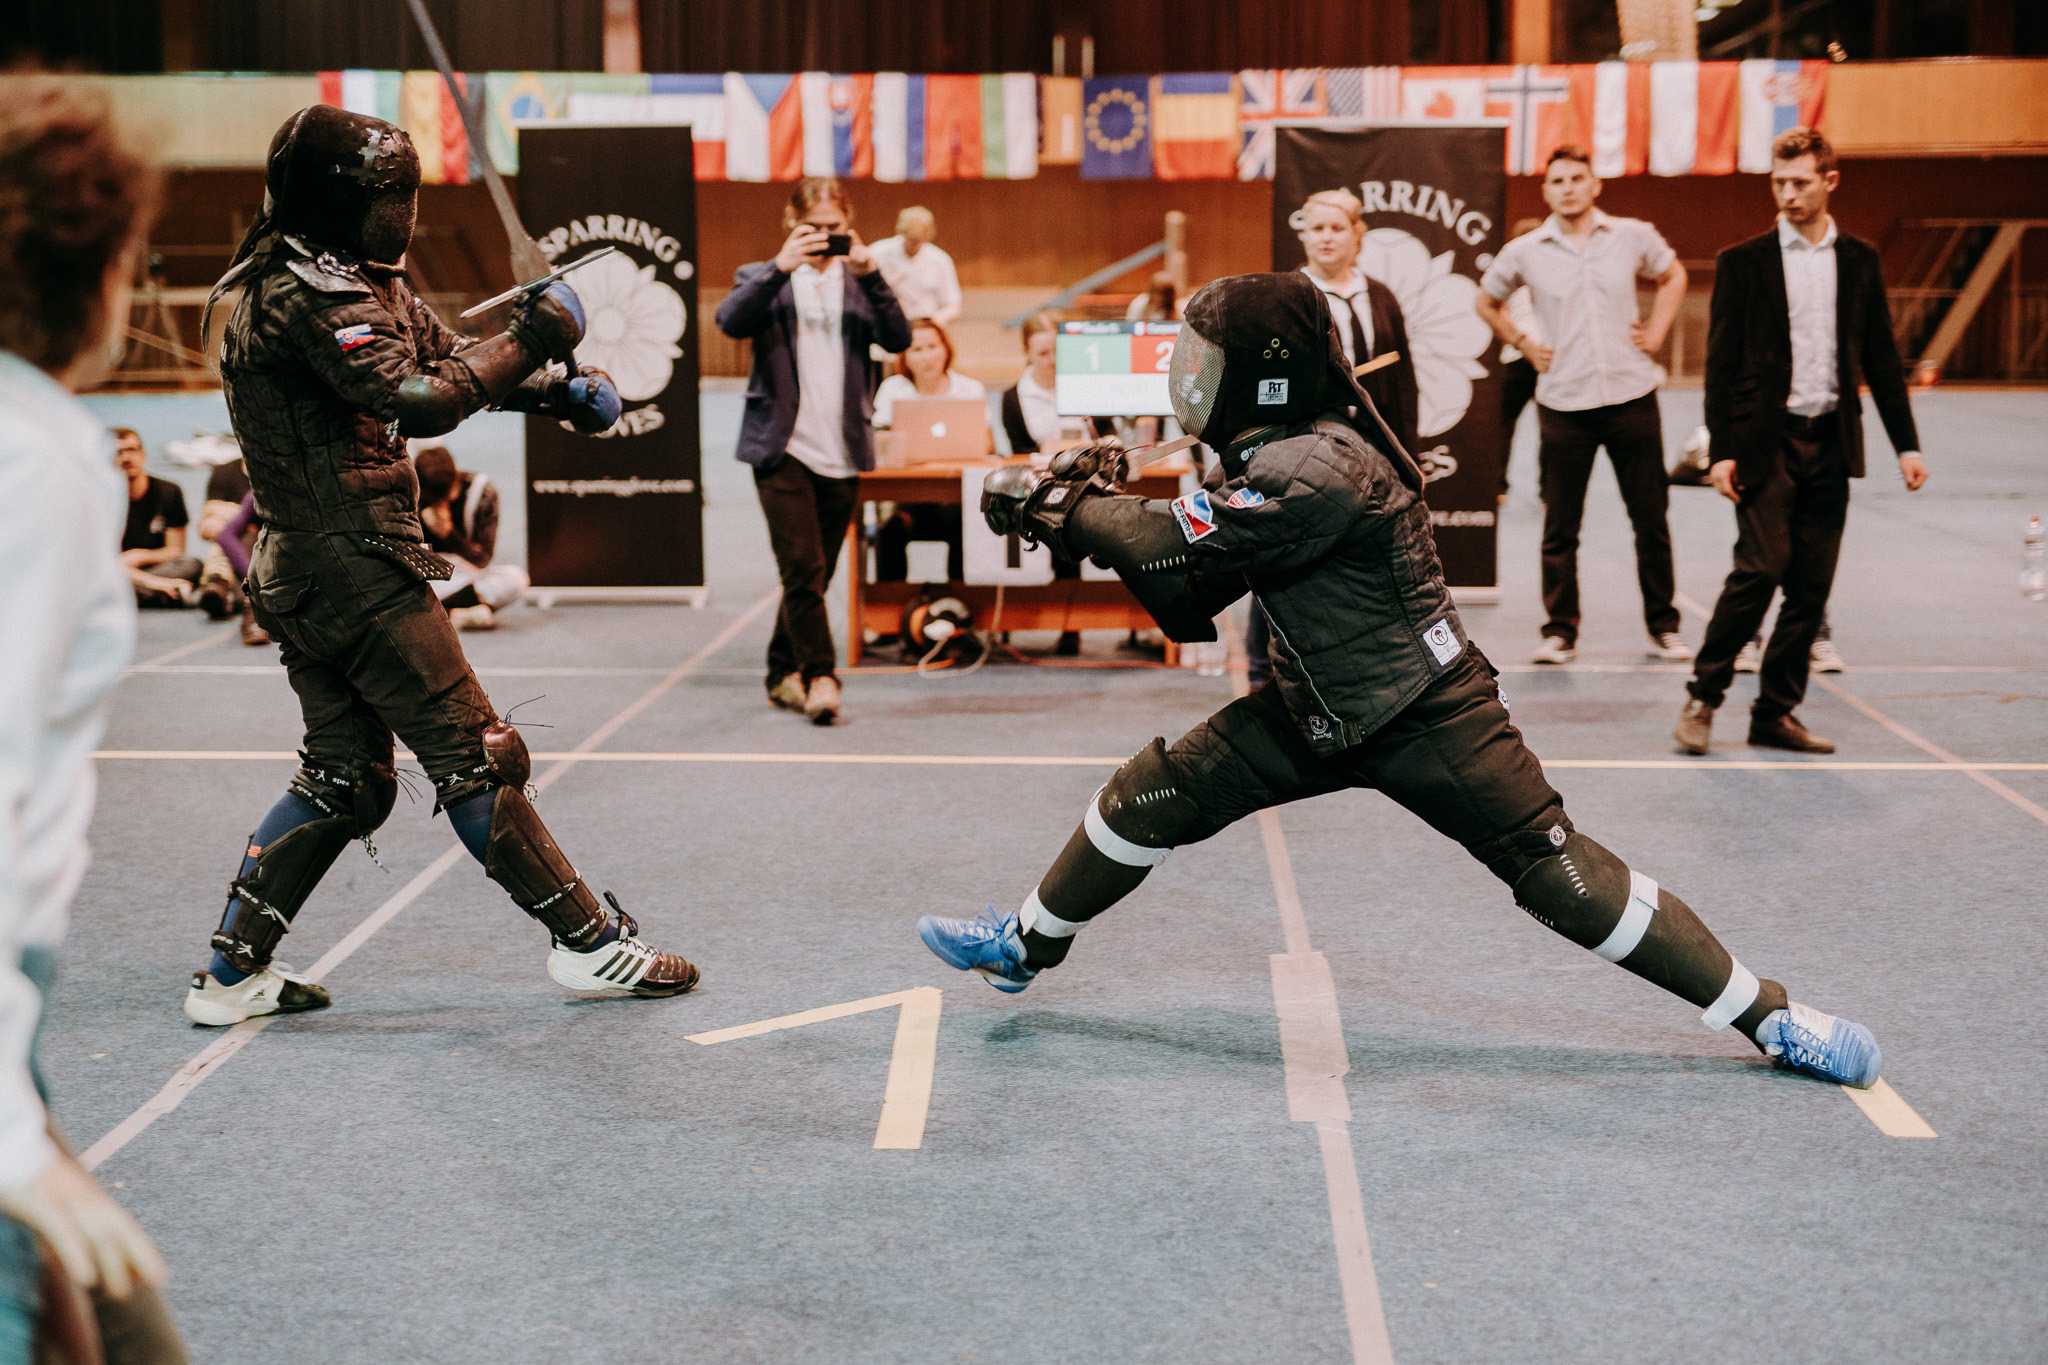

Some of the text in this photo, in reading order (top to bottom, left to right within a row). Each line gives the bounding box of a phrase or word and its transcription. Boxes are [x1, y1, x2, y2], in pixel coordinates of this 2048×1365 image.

[539, 214, 681, 263] SPARRING
[1086, 340, 1174, 372] 1 2
